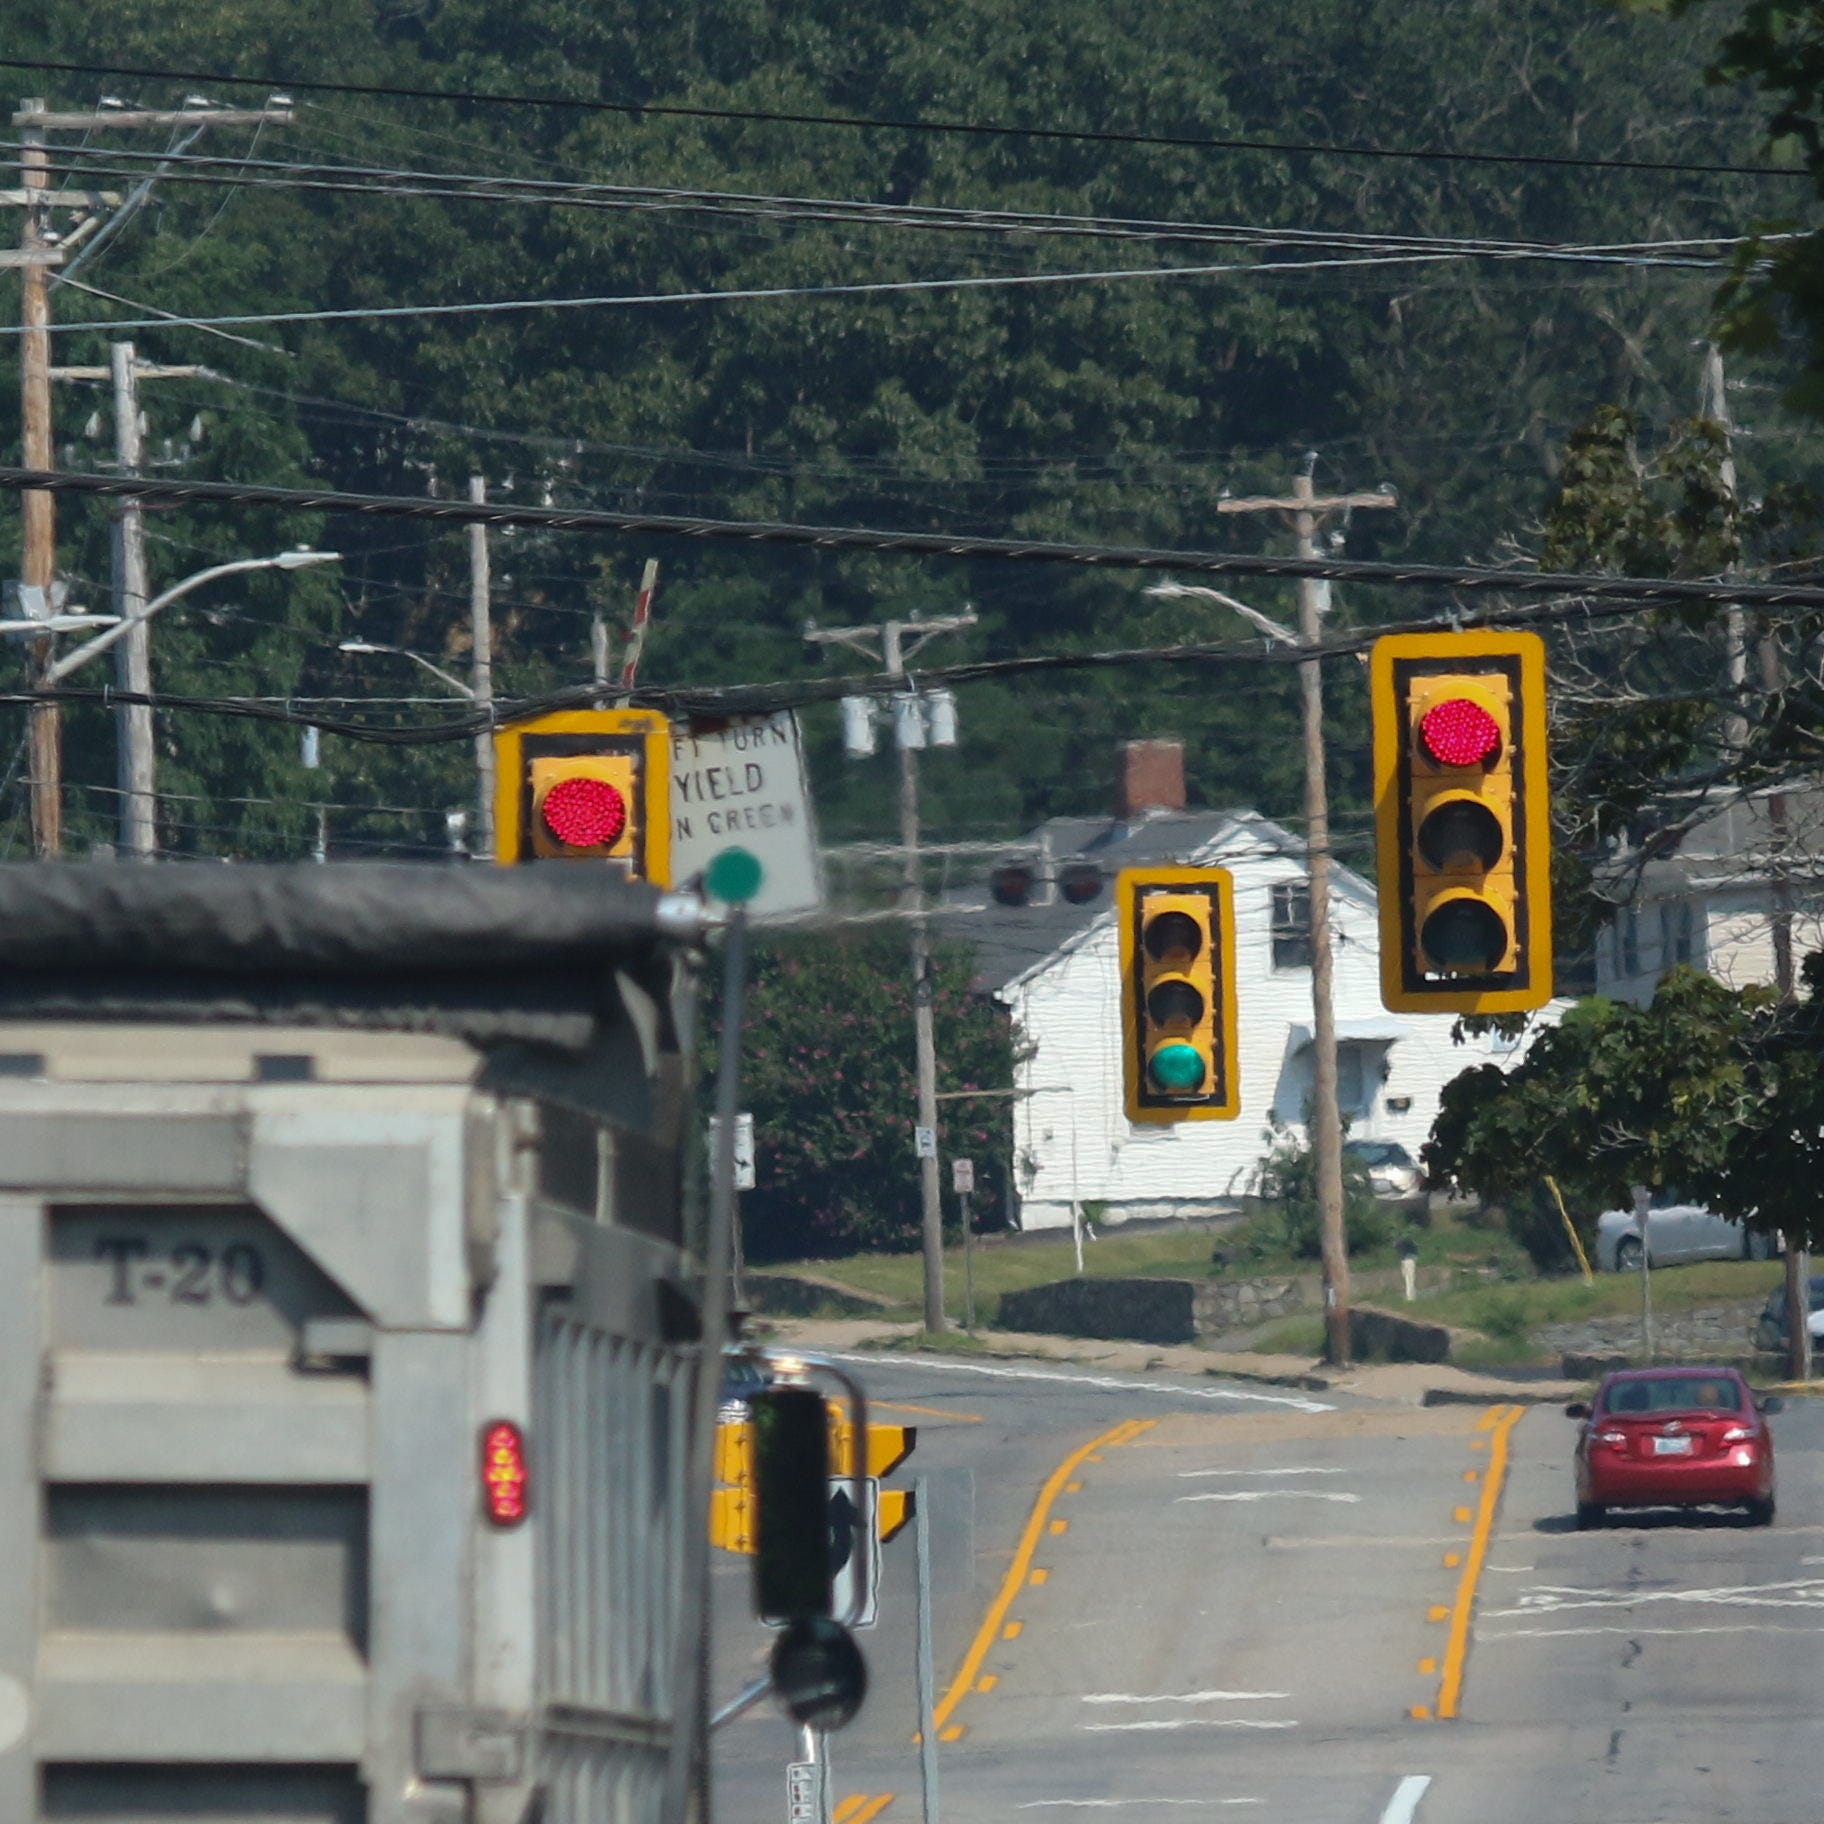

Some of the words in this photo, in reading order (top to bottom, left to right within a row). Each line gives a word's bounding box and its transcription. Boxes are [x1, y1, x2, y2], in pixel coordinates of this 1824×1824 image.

[674, 763, 762, 802] YIELD
[706, 803, 793, 834] GREEN
[94, 1236, 265, 1307] T-20
